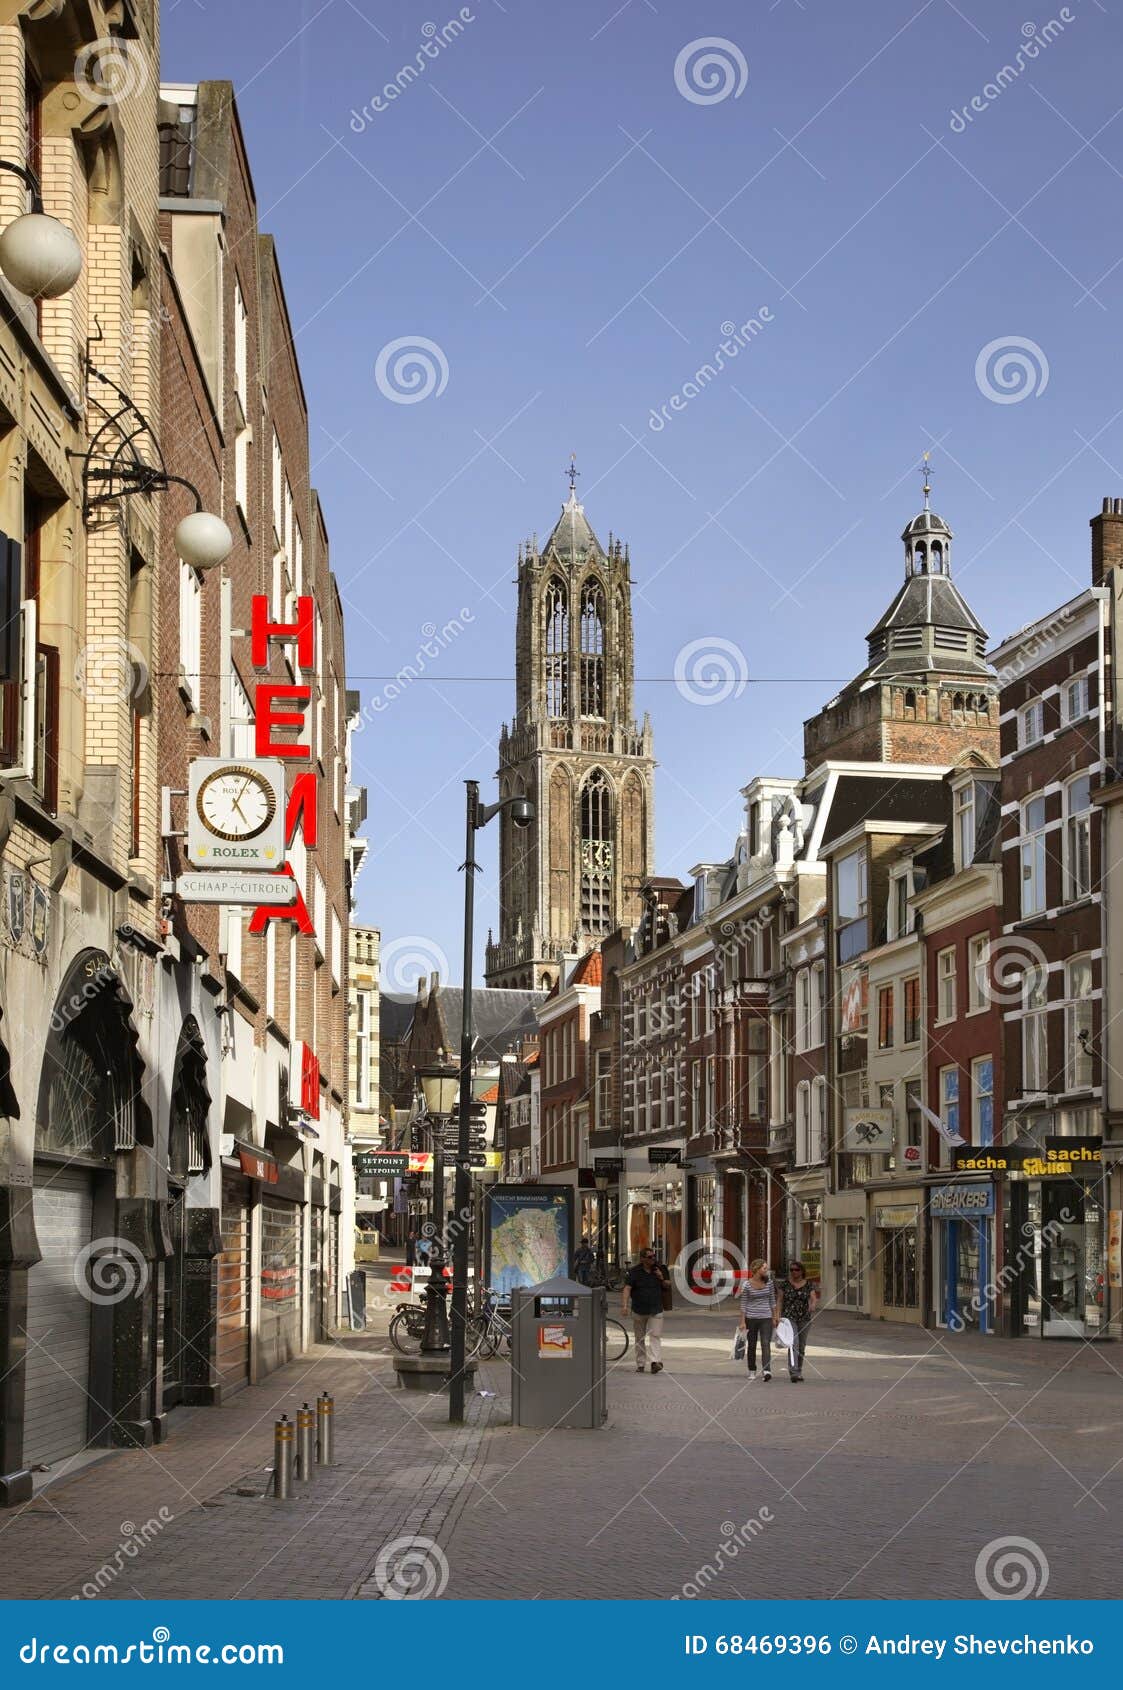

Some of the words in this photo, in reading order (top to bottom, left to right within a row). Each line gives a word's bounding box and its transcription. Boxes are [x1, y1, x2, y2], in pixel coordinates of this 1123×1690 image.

[213, 848, 259, 858] ROLEX
[1047, 1147, 1103, 1161] sacha
[362, 1157, 405, 1165] SETPOINT
[956, 1156, 1007, 1169] sacha
[931, 1191, 987, 1208] SNEAKERS
